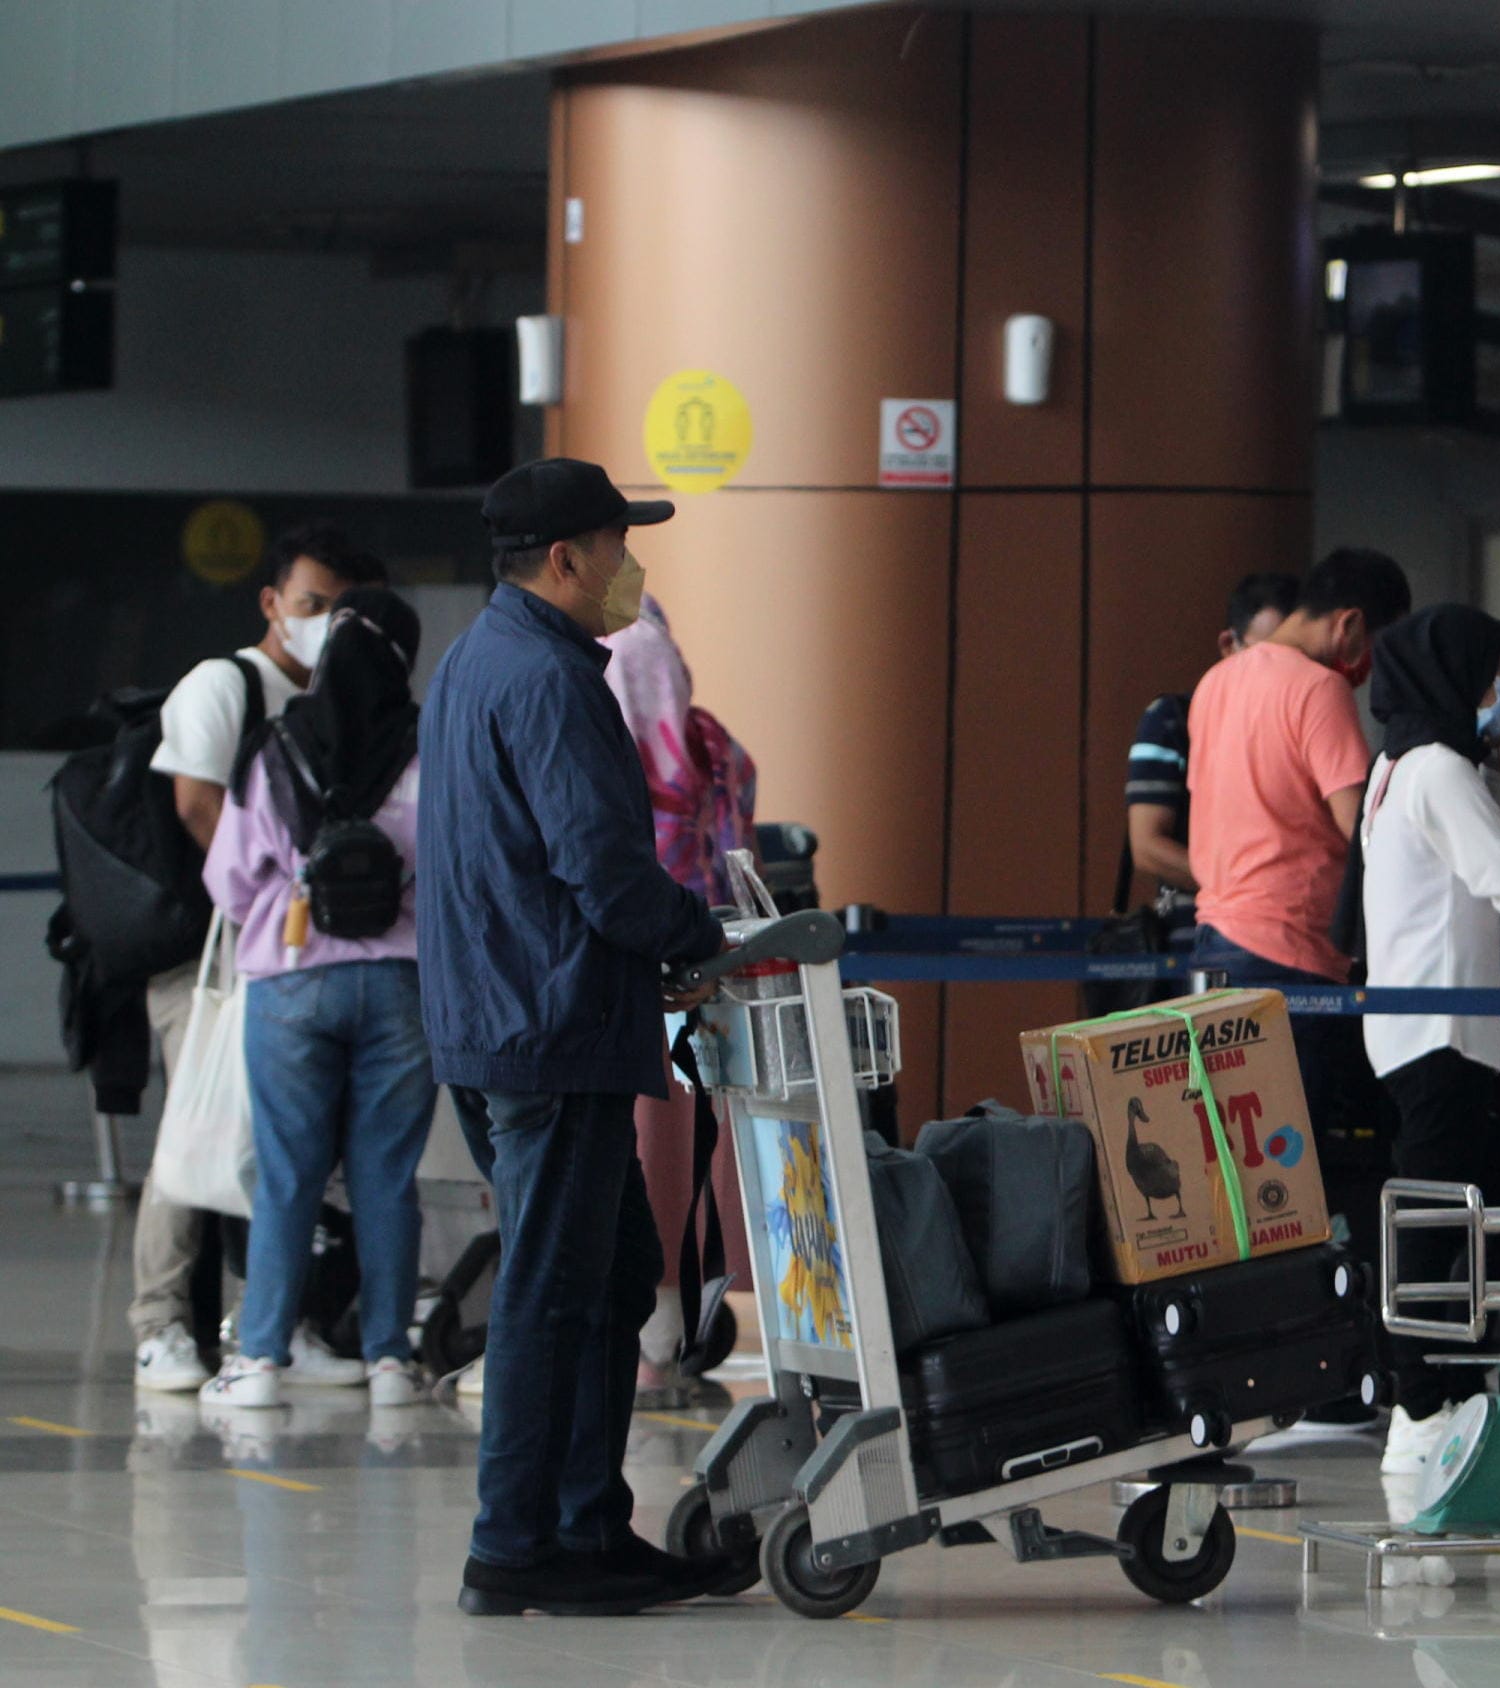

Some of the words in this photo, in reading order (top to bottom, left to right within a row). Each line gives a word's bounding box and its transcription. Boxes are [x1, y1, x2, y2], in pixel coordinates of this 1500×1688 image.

[1110, 1029, 1190, 1069] TELUR
[1200, 1017, 1261, 1050] ASIN
[1205, 1048, 1246, 1074] ERAH
[1157, 1241, 1209, 1267] MUTU
[1251, 1220, 1303, 1247] JAMIN
